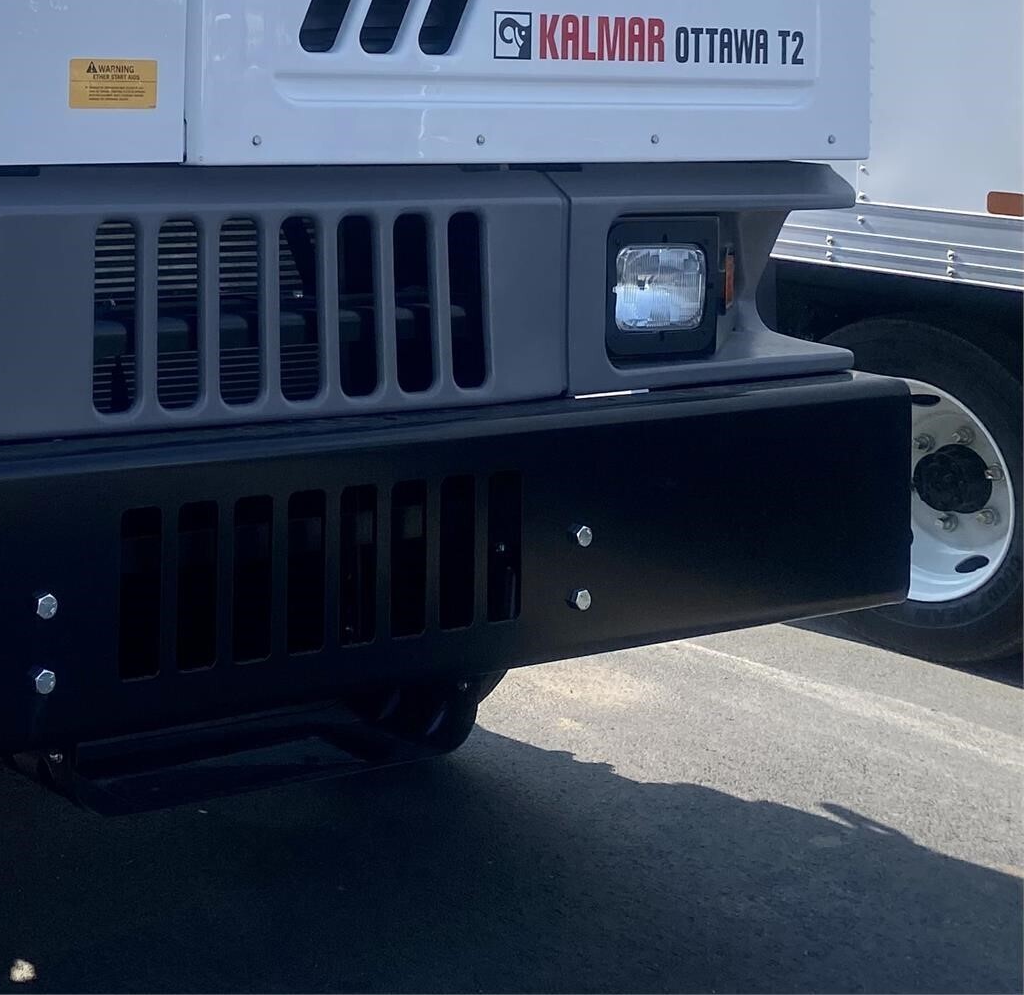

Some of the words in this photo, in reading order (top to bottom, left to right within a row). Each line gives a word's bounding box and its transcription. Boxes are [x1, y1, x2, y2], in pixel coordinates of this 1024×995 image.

[539, 13, 665, 63] KALMAR
[675, 26, 769, 65] OTTAWA
[777, 29, 805, 66] T2
[98, 64, 135, 74] WARNING
